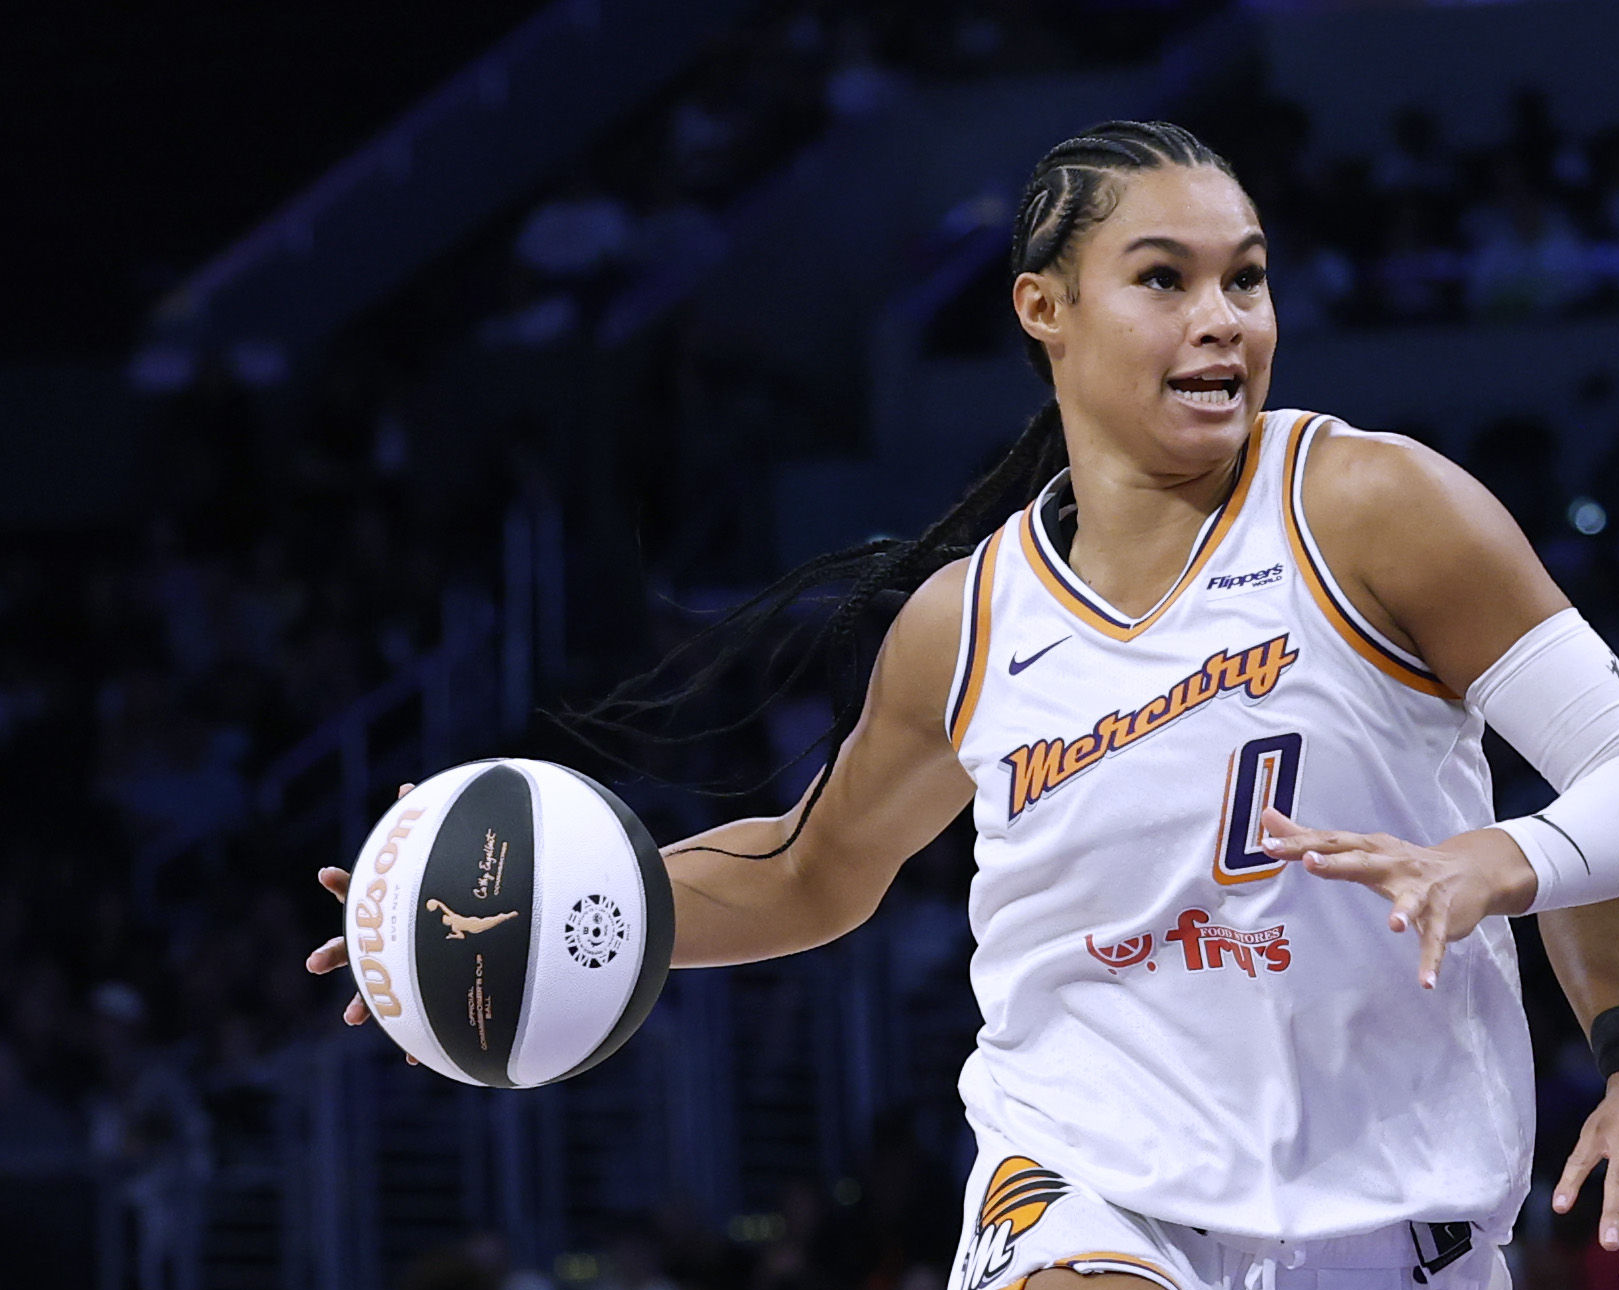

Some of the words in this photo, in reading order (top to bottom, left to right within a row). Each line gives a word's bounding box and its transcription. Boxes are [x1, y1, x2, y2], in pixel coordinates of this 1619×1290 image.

[1001, 632, 1299, 824] Mercury
[1212, 731, 1305, 886] 0
[355, 806, 426, 1021] Wilson
[1200, 927, 1233, 938] FOOD
[1234, 928, 1281, 944] STORES
[475, 954, 483, 977] CUP
[484, 995, 492, 1019] BALL
